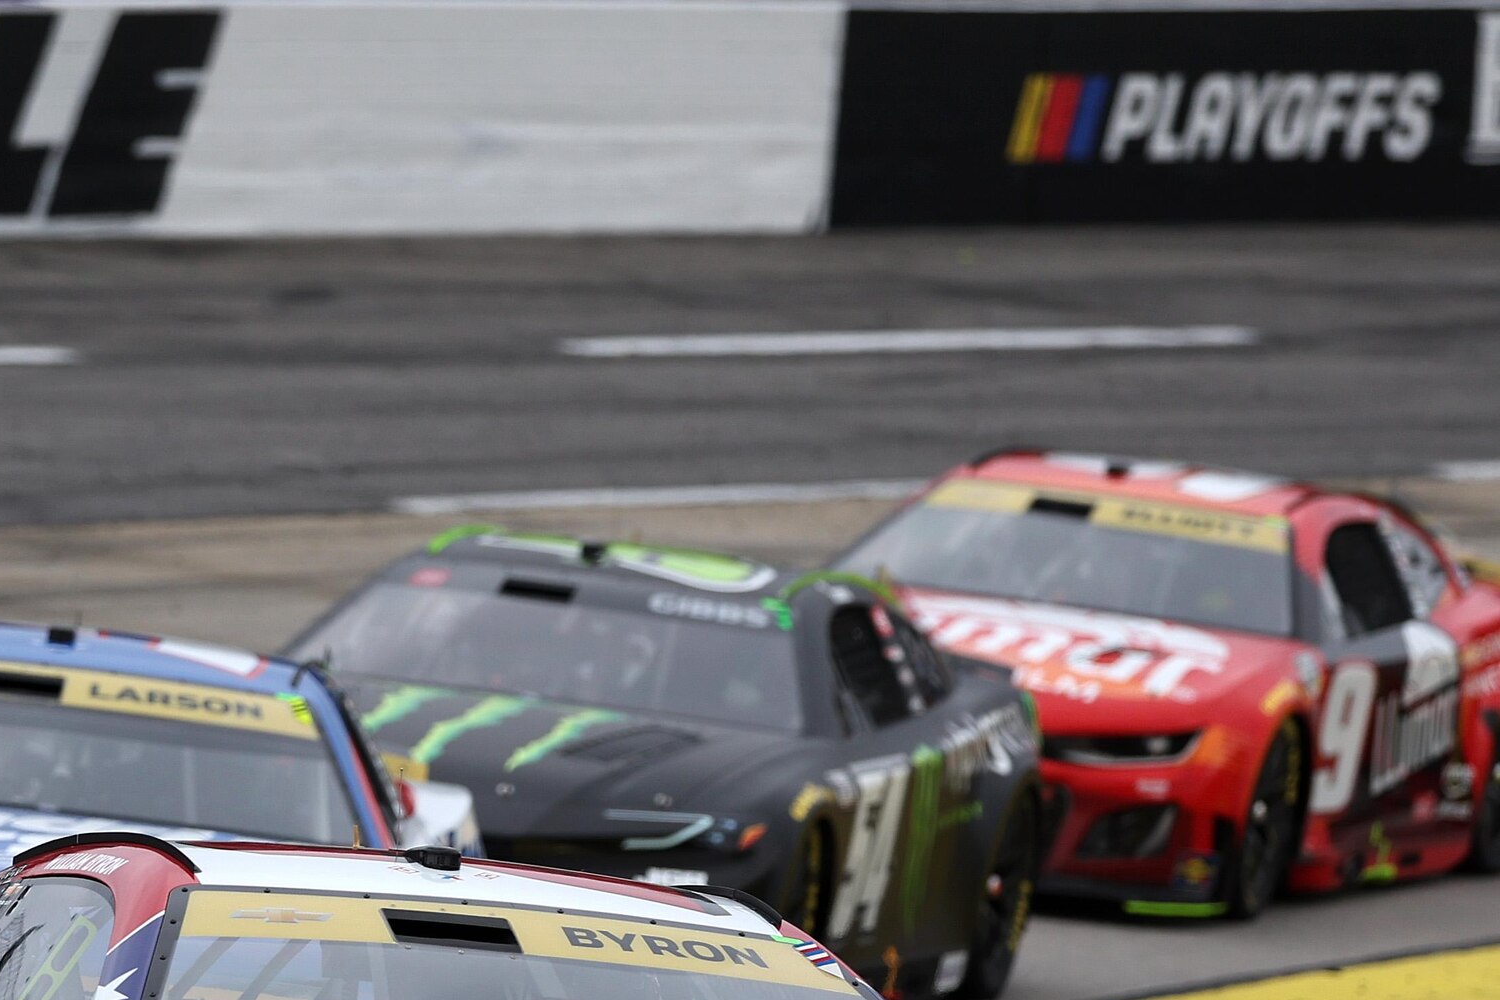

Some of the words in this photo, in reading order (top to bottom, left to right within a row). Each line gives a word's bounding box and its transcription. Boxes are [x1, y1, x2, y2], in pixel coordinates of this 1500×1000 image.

[1104, 71, 1441, 164] PLAYOFFS
[90, 682, 264, 719] LARSON
[1307, 660, 1378, 814] 9
[561, 926, 769, 969] BYRON
